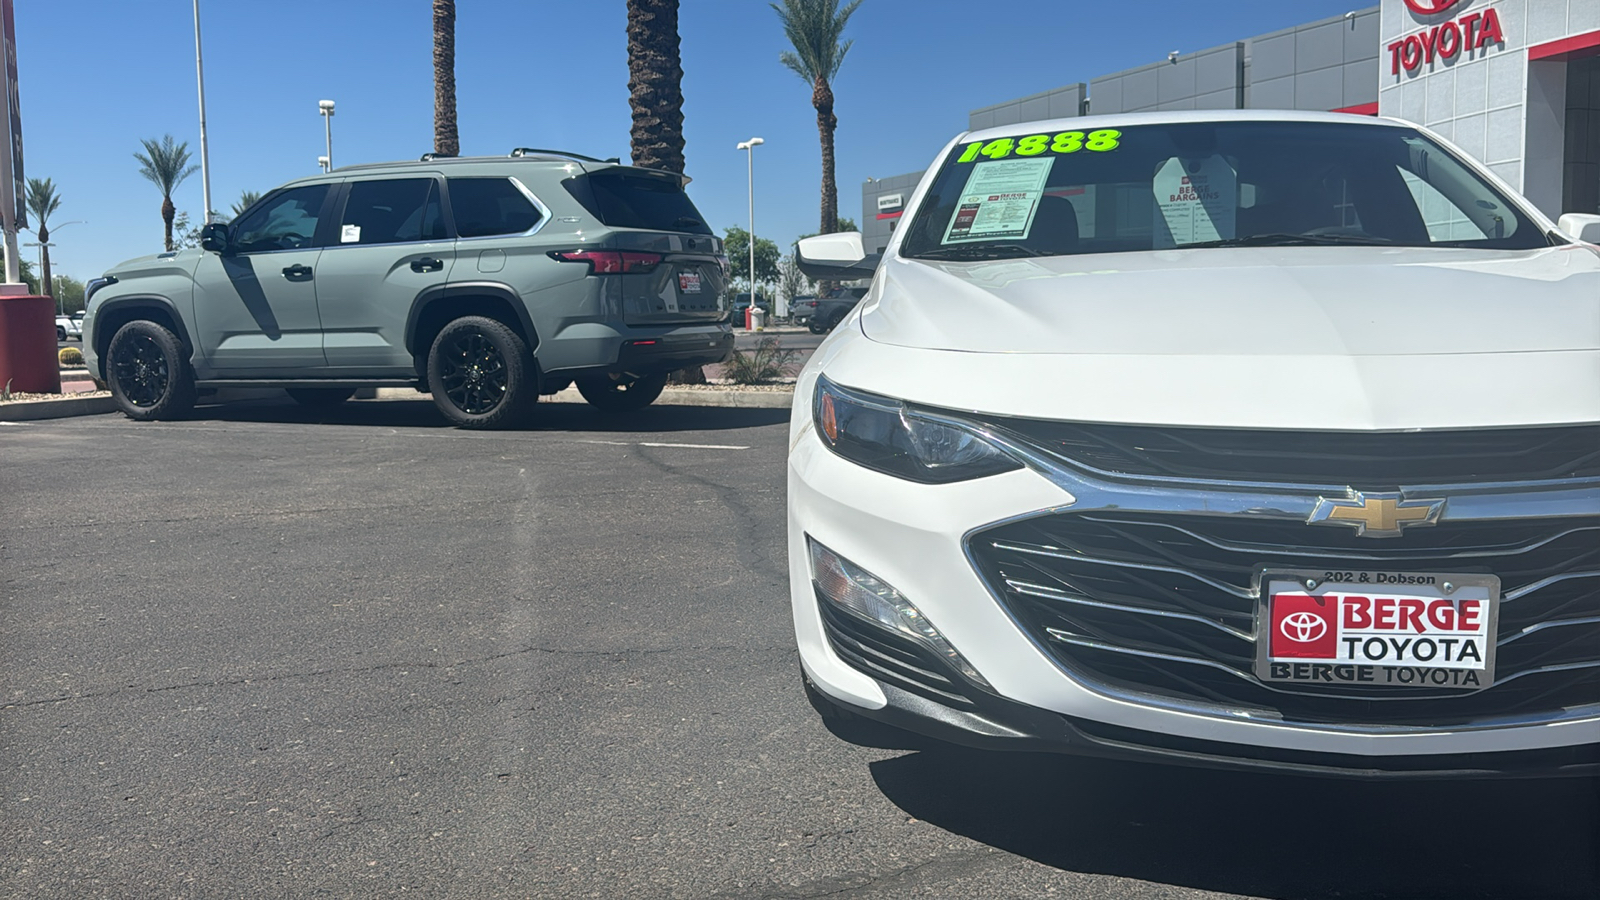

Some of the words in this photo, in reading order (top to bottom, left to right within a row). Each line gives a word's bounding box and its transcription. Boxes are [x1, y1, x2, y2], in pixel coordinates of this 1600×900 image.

[1387, 8, 1503, 76] TOYOTA
[957, 129, 1122, 163] 14888
[1169, 192, 1219, 202] BARGAINS
[1179, 185, 1210, 194] BERGE
[1324, 572, 1353, 584] 202
[1358, 573, 1371, 584] &
[1376, 573, 1436, 585] Dobson
[1342, 596, 1481, 634] BERGE
[1342, 637, 1482, 662] TOYOTA
[1270, 662, 1375, 682] BERGE
[1382, 667, 1480, 686] TOYOTA
